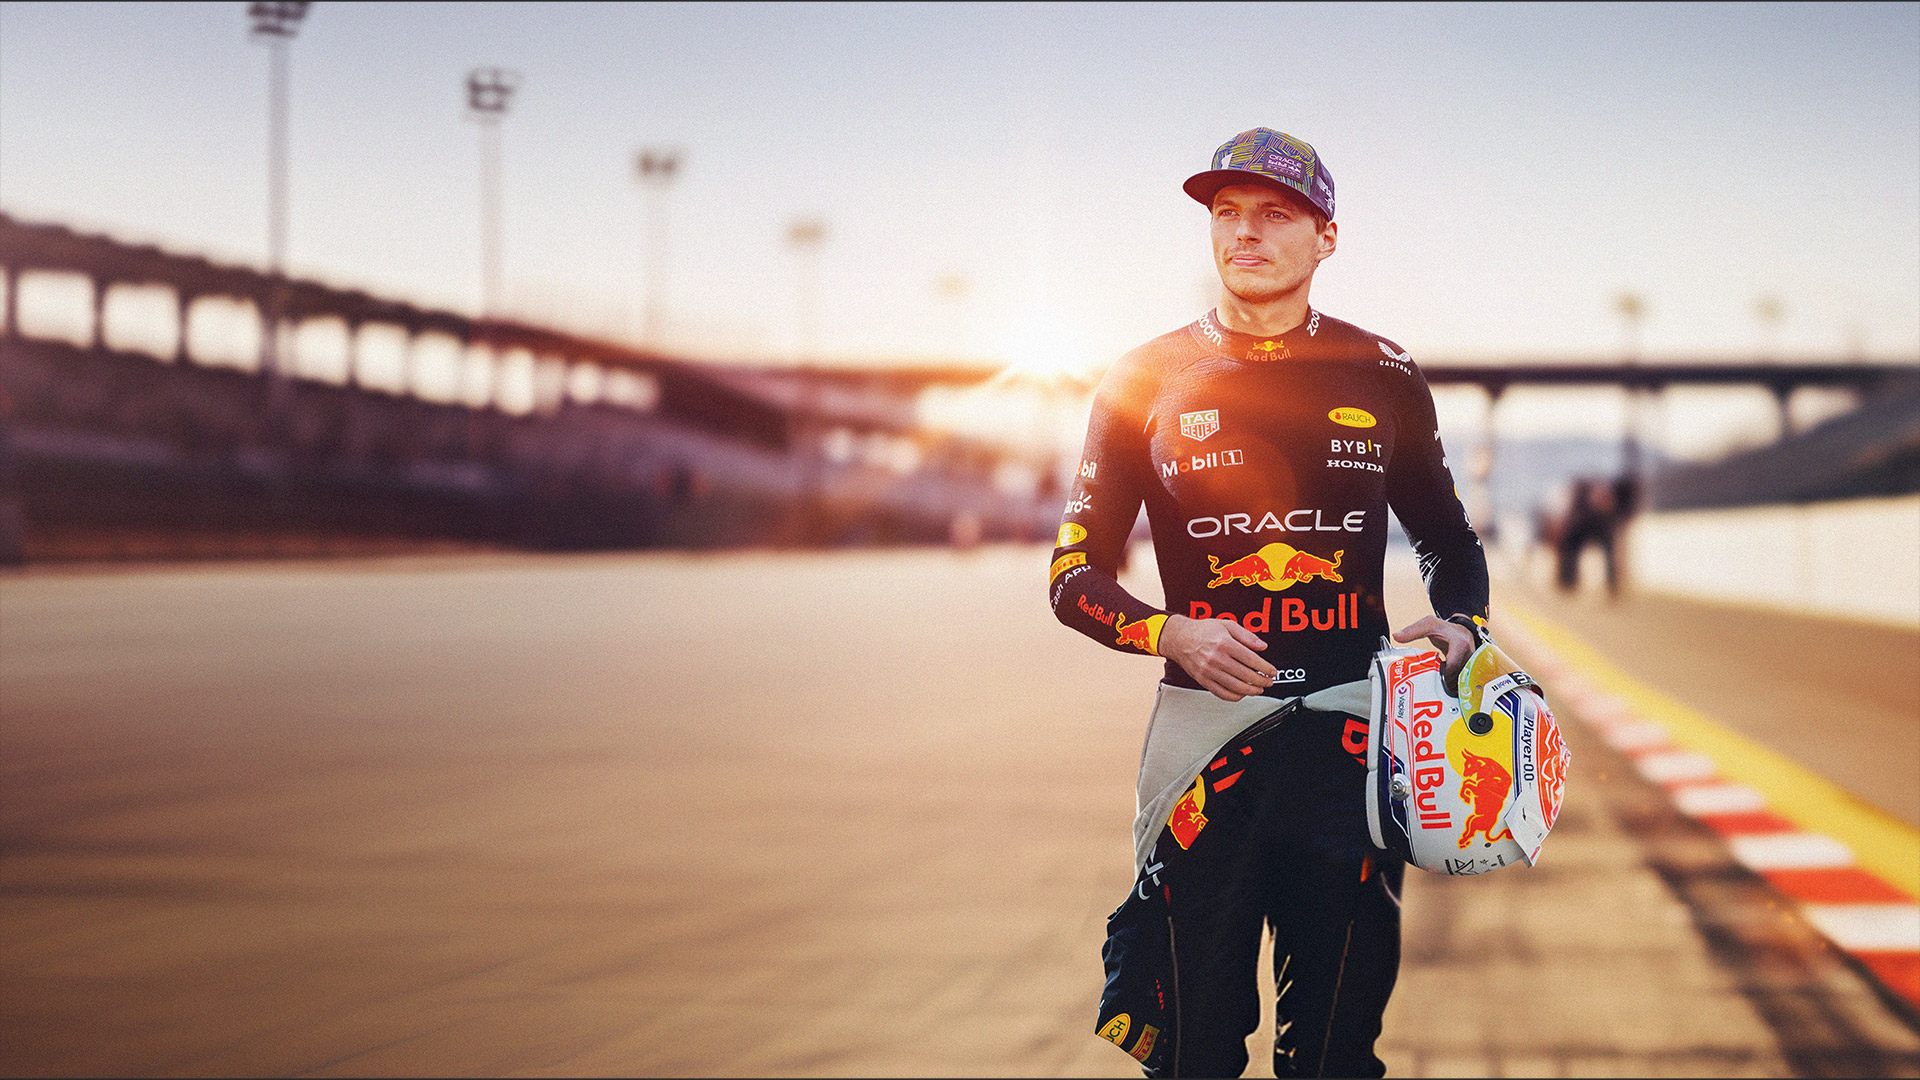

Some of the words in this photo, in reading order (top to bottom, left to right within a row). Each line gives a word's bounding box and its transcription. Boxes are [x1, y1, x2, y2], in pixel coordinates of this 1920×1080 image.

[1245, 351, 1268, 362] Red
[1269, 348, 1292, 361] Bull
[1379, 360, 1412, 376] CASTORE
[1183, 412, 1216, 424] TAG
[1342, 412, 1371, 424] RAUCH
[1183, 423, 1217, 439] HEUER
[1331, 439, 1382, 458] BYBIT
[1162, 452, 1218, 479] Mobil
[1326, 460, 1384, 473] HONDA
[1187, 509, 1366, 538] ORACLE
[1077, 593, 1099, 618] Red
[1094, 605, 1116, 627] Bull
[1281, 593, 1358, 632] Bull
[1413, 700, 1446, 762] Red
[1521, 716, 1535, 762] Player
[1523, 763, 1535, 781] 0.0
[1415, 766, 1453, 830] Bull
